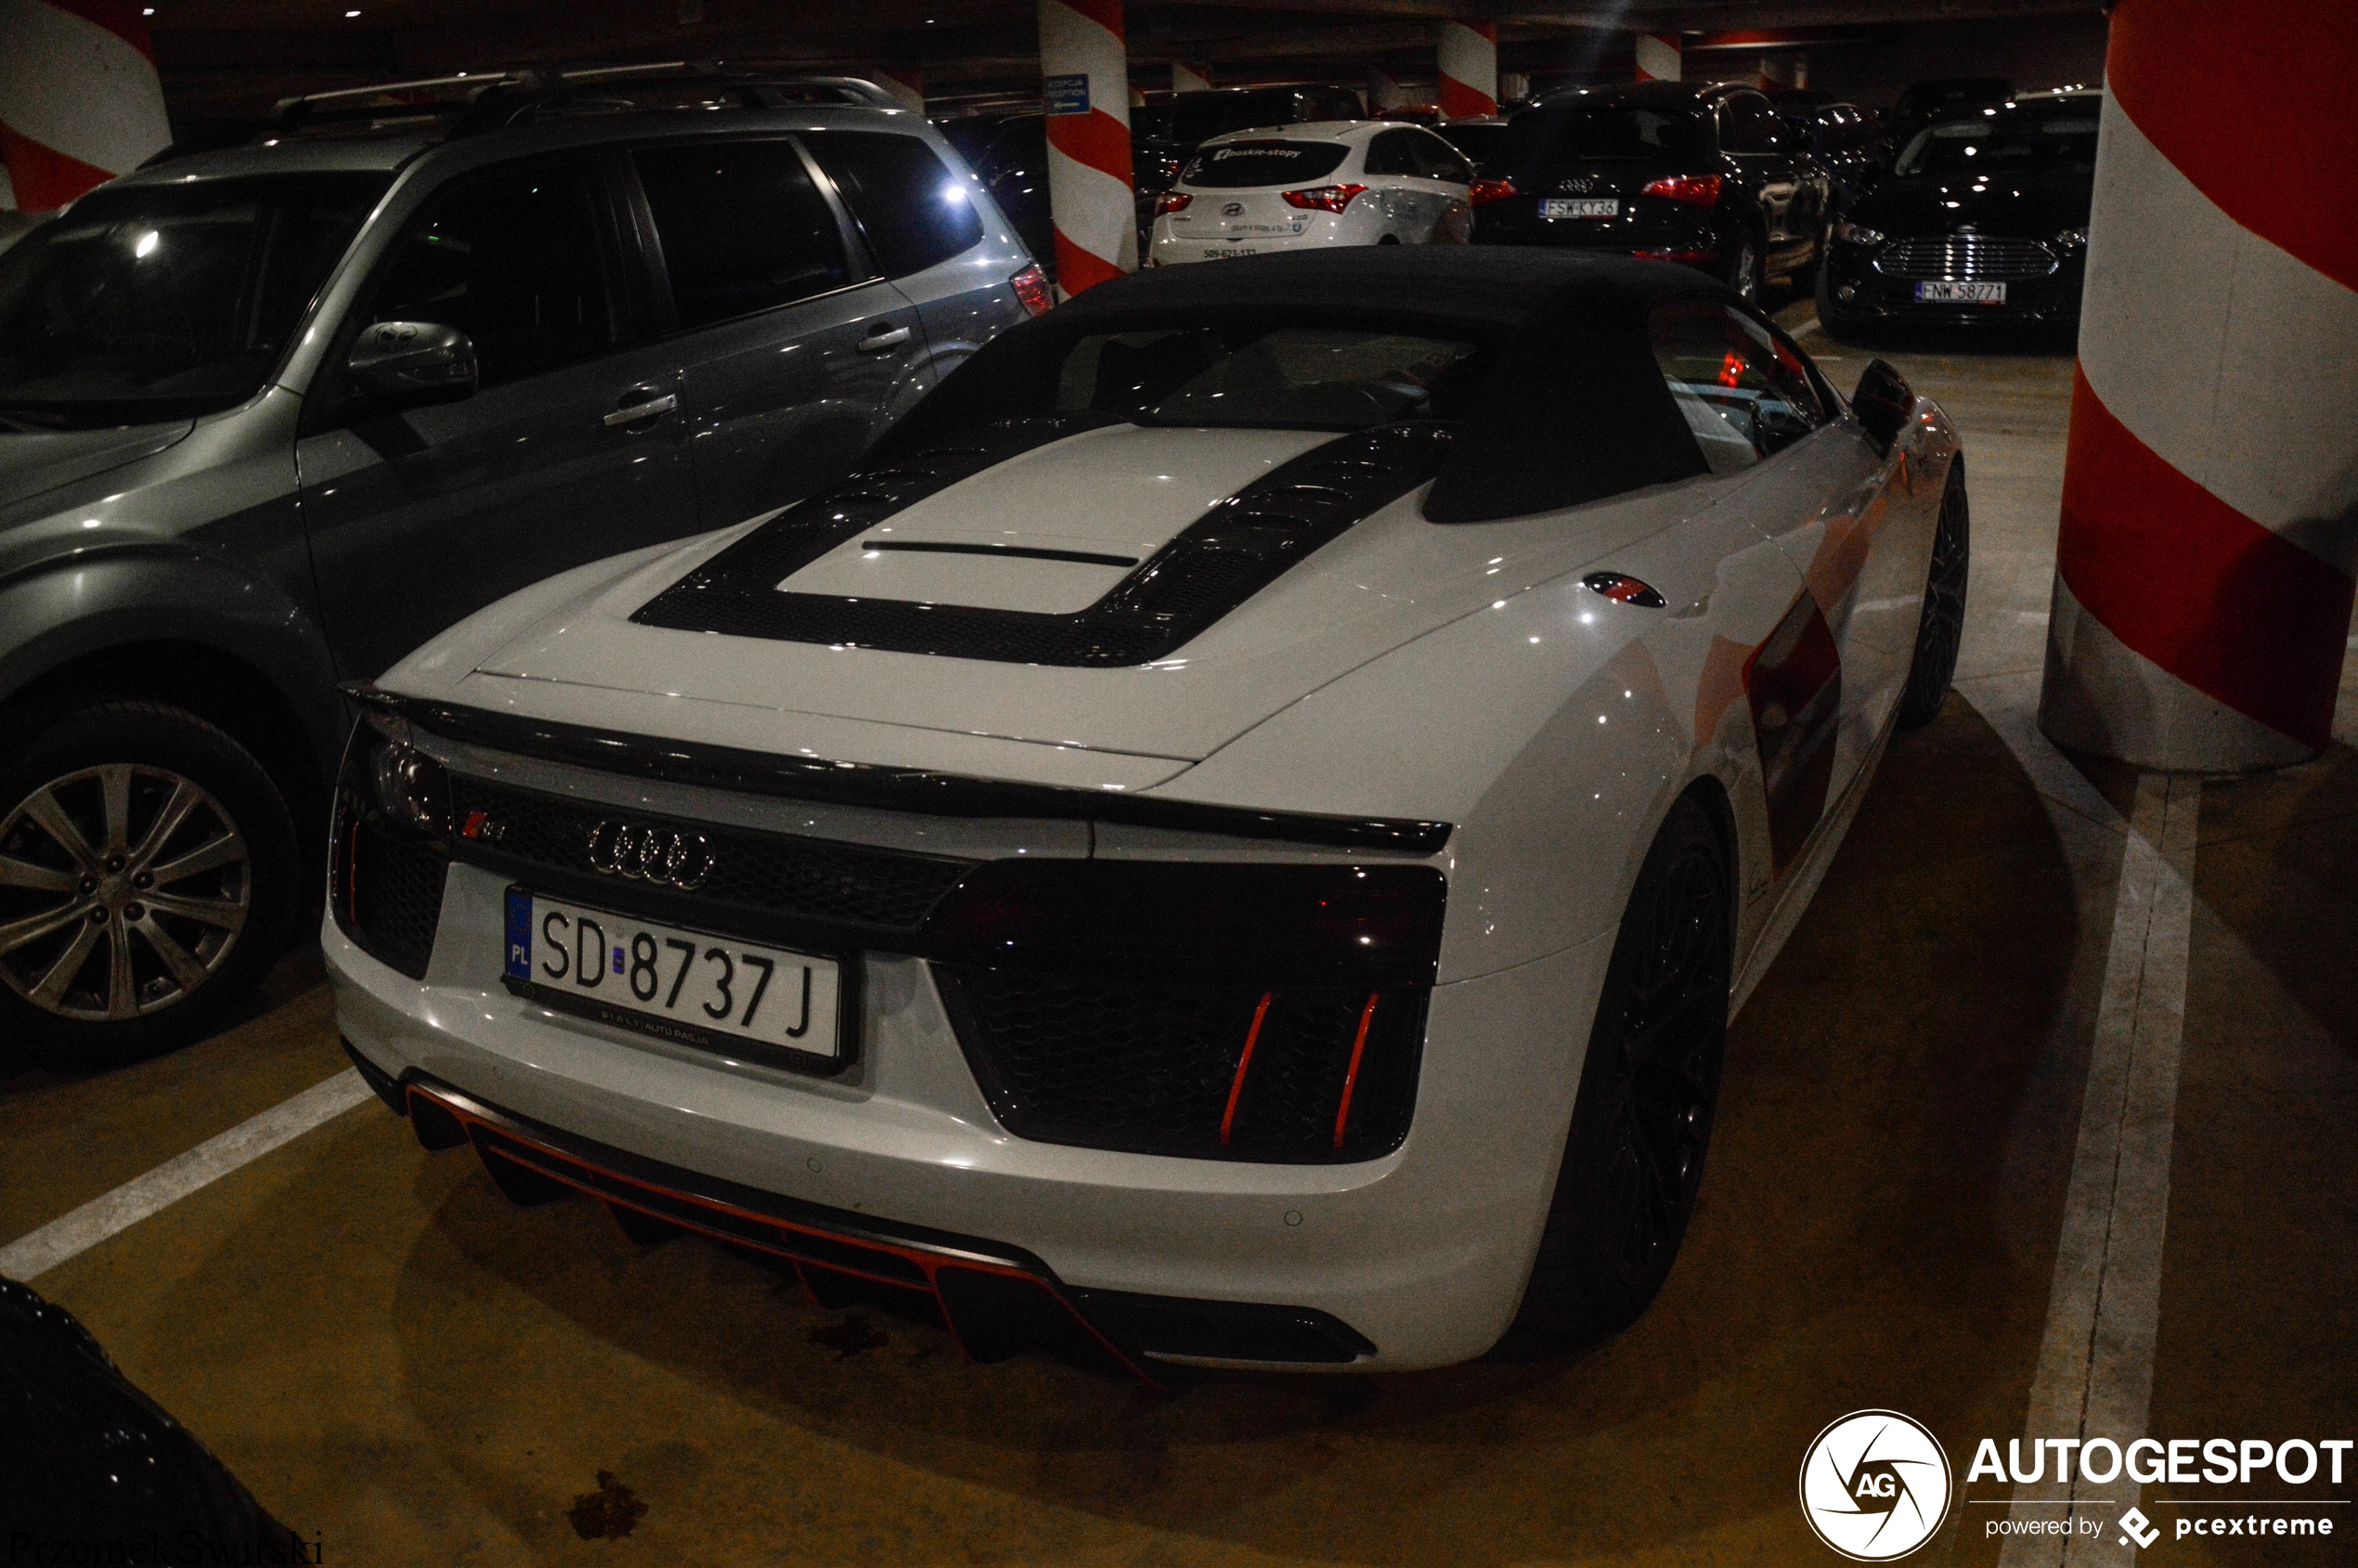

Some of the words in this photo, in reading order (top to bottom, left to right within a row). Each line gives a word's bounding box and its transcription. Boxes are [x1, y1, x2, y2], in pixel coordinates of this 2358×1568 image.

[1548, 201, 1574, 214] FSW
[1580, 201, 1614, 214] KY36
[1924, 283, 1952, 299] FNW
[1958, 284, 2002, 299] 58771
[511, 942, 529, 966] PL
[541, 911, 606, 988] SD
[629, 931, 811, 1038] 8737J
[644, 1022, 673, 1037] AUTO
[674, 1030, 710, 1045] PASJA
